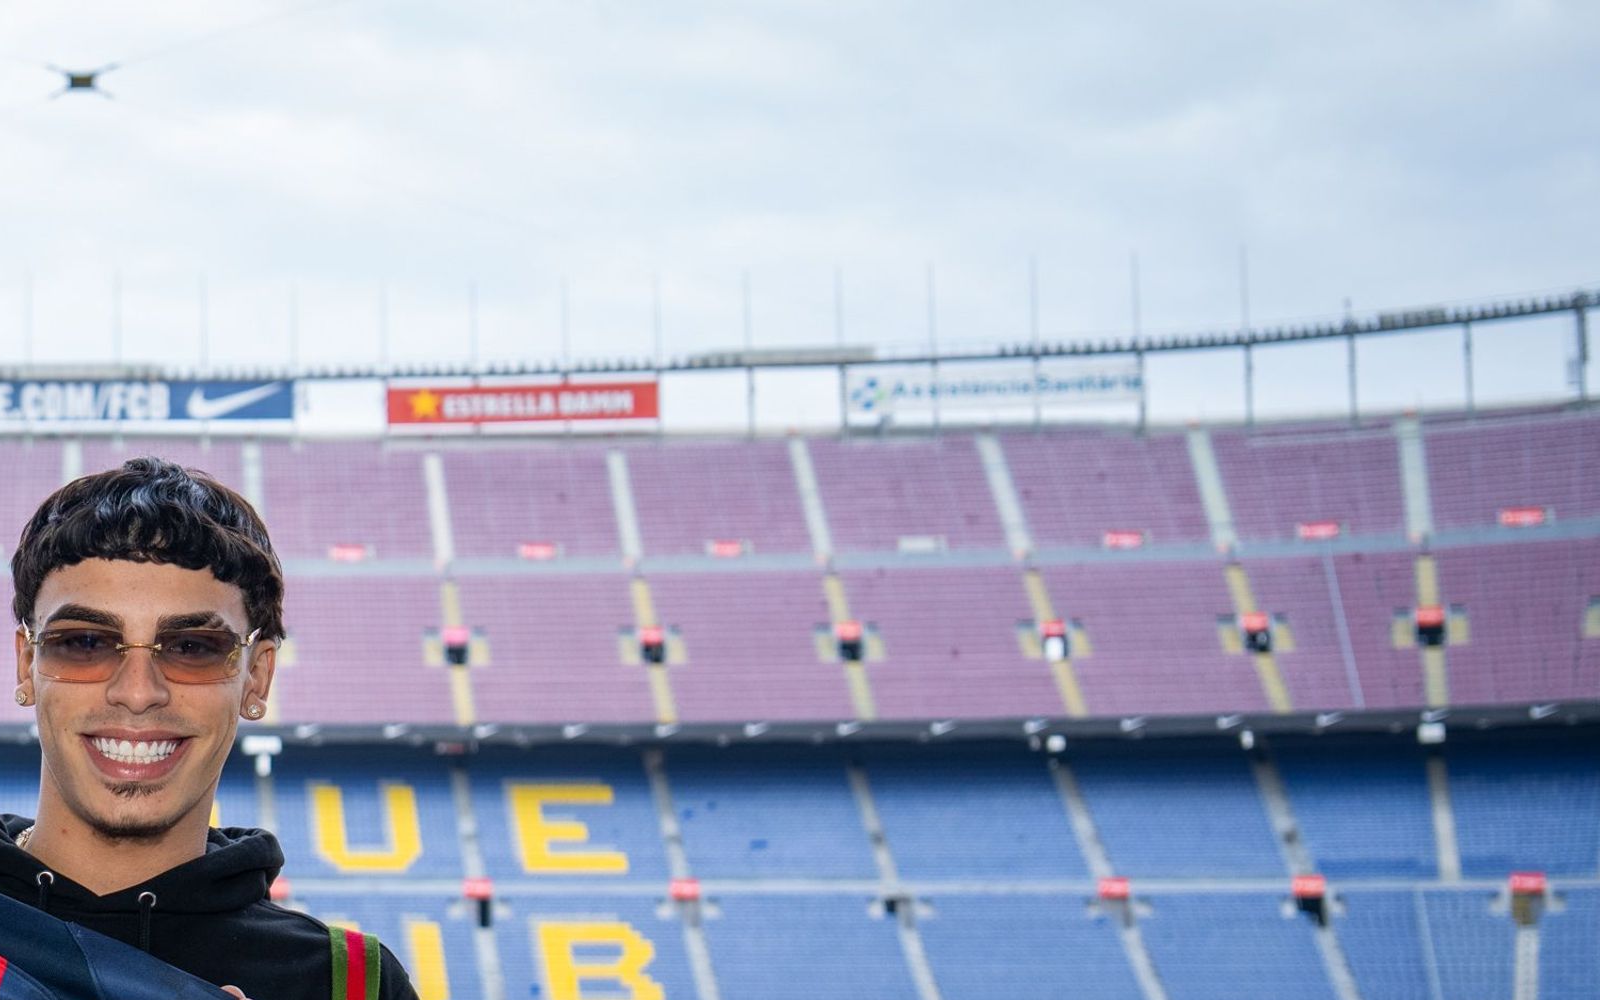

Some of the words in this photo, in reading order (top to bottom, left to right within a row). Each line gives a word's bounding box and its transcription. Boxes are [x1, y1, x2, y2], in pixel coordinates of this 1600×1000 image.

[442, 393, 553, 418] ESTRELLA
[557, 390, 635, 415] DAMM
[208, 782, 629, 873] UE
